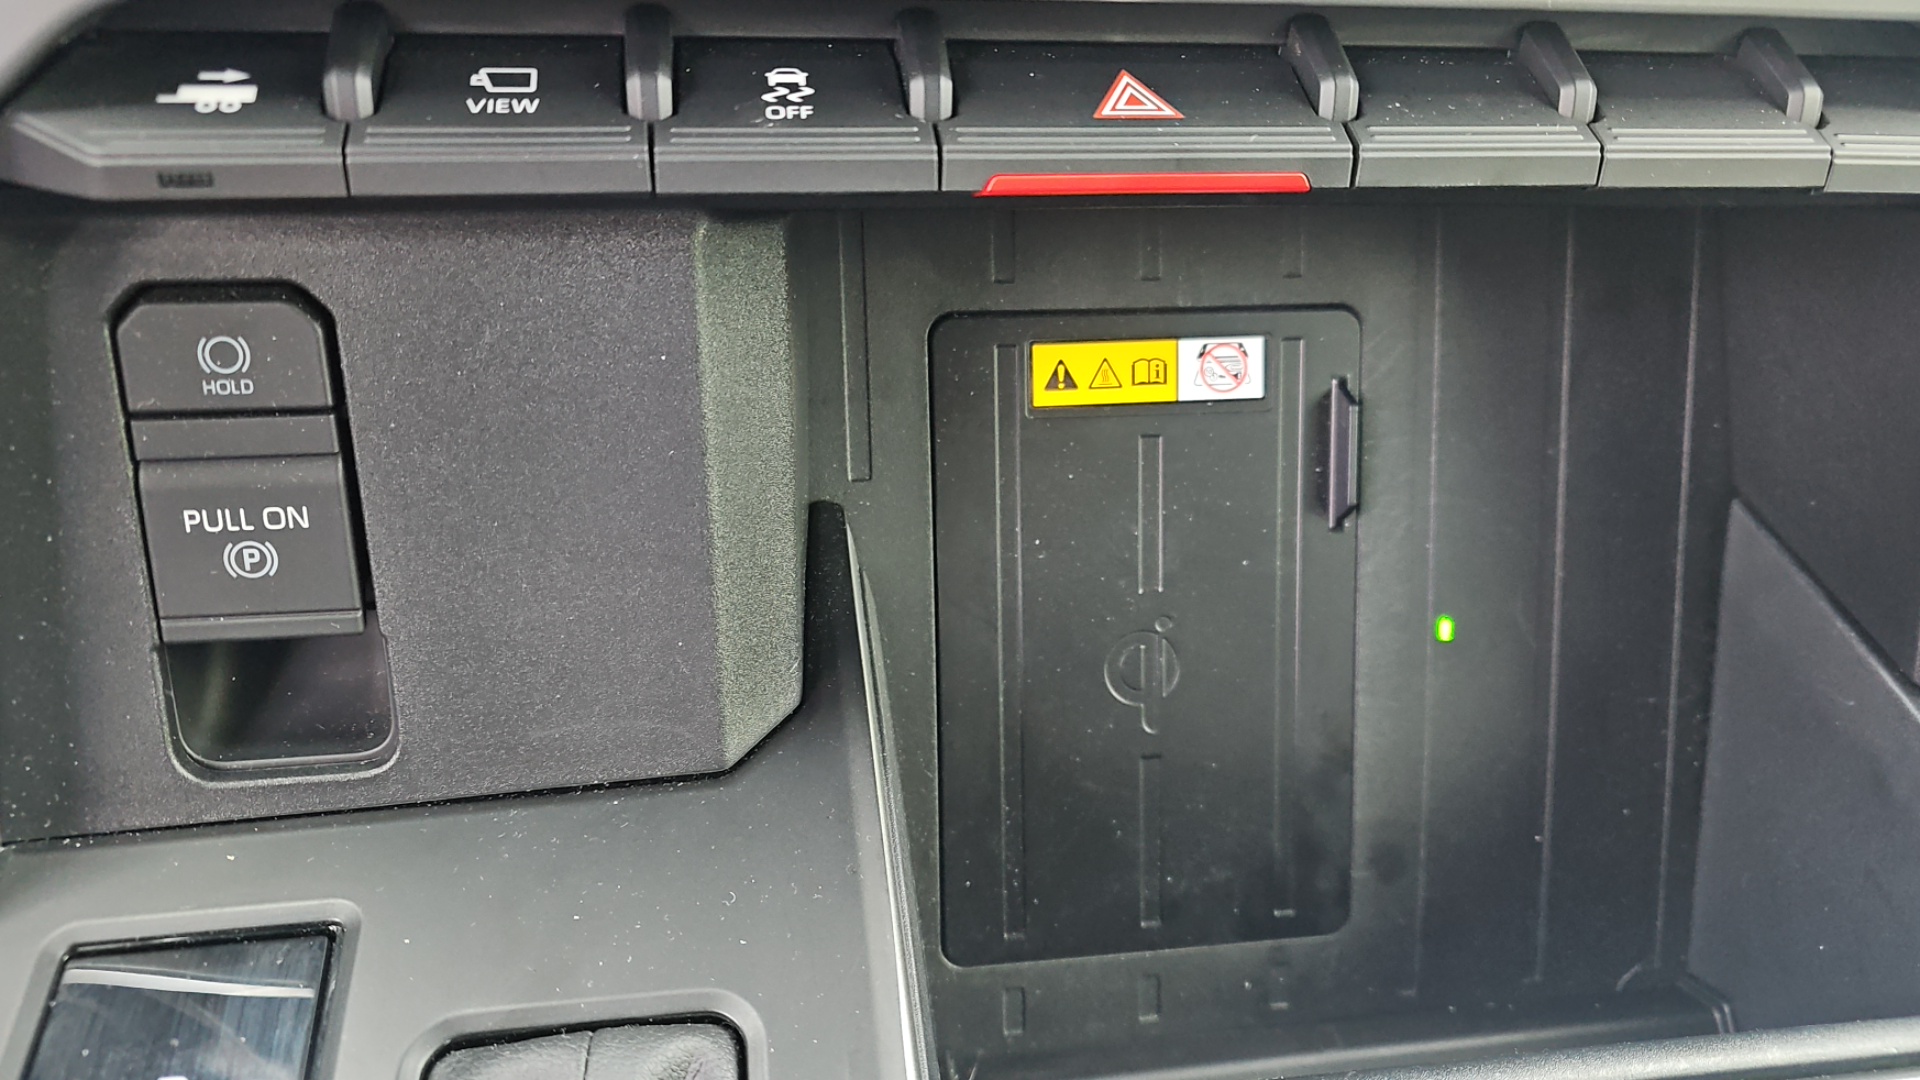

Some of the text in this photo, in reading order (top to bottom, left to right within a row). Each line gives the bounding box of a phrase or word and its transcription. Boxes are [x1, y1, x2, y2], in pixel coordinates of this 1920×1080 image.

[465, 97, 541, 114] VIEW
[764, 105, 815, 120] OFF
[202, 378, 255, 396] HOLD
[183, 505, 310, 533] PULL ON
